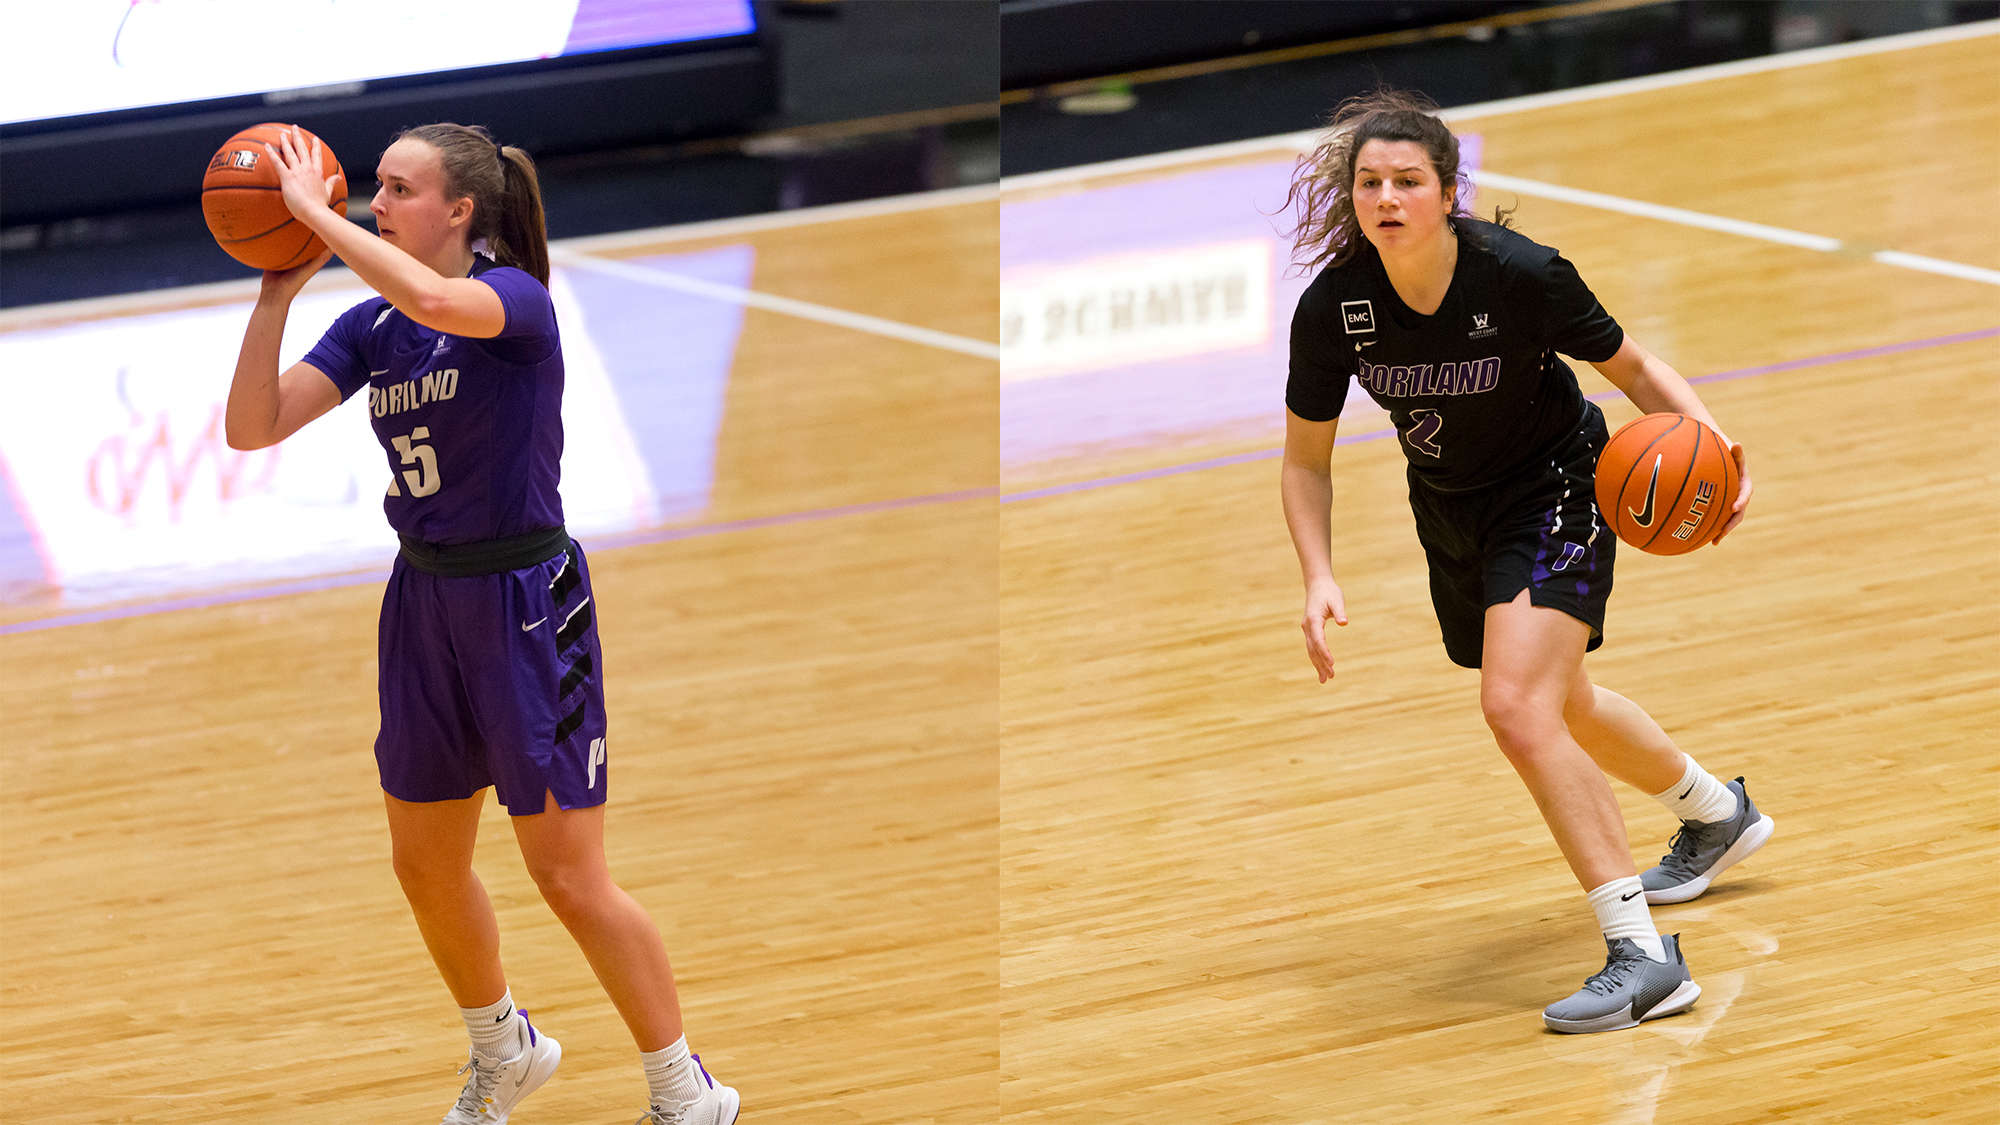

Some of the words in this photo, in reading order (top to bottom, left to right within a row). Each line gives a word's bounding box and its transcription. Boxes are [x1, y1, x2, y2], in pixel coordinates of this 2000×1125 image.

[210, 150, 260, 169] ELITE
[1347, 312, 1369, 323] EMC
[369, 368, 459, 420] PORTLND
[1359, 356, 1501, 397] PORTLAND
[1405, 408, 1443, 458] 2
[1671, 479, 1714, 541] ELITE
